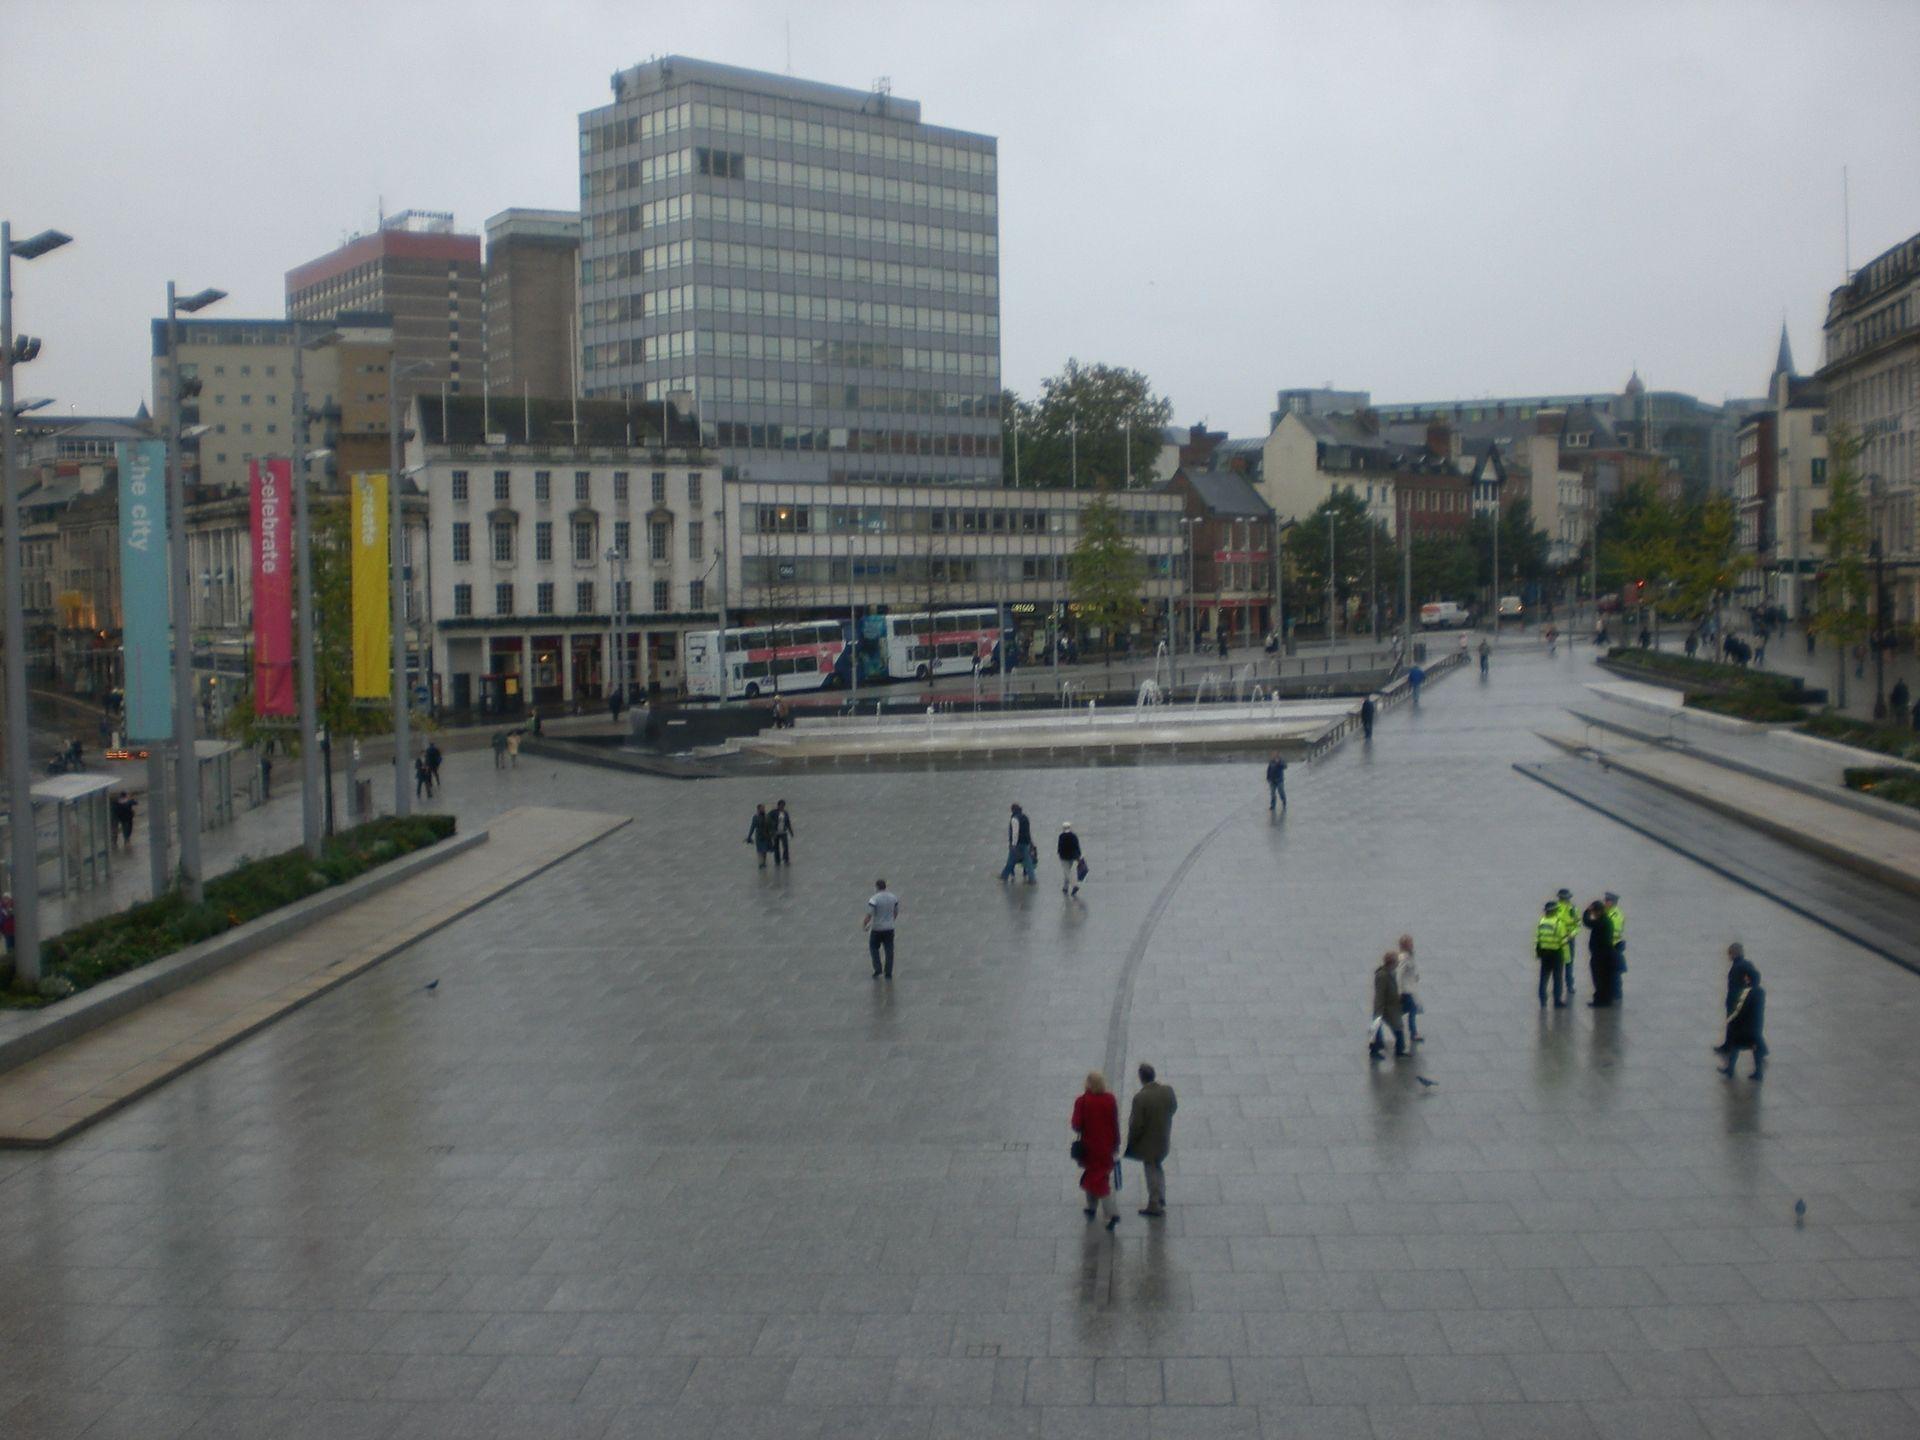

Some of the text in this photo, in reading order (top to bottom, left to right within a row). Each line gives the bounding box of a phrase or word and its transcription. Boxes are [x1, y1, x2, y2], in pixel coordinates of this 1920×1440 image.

[128, 455, 152, 552] the city
[261, 471, 280, 573] celebrate
